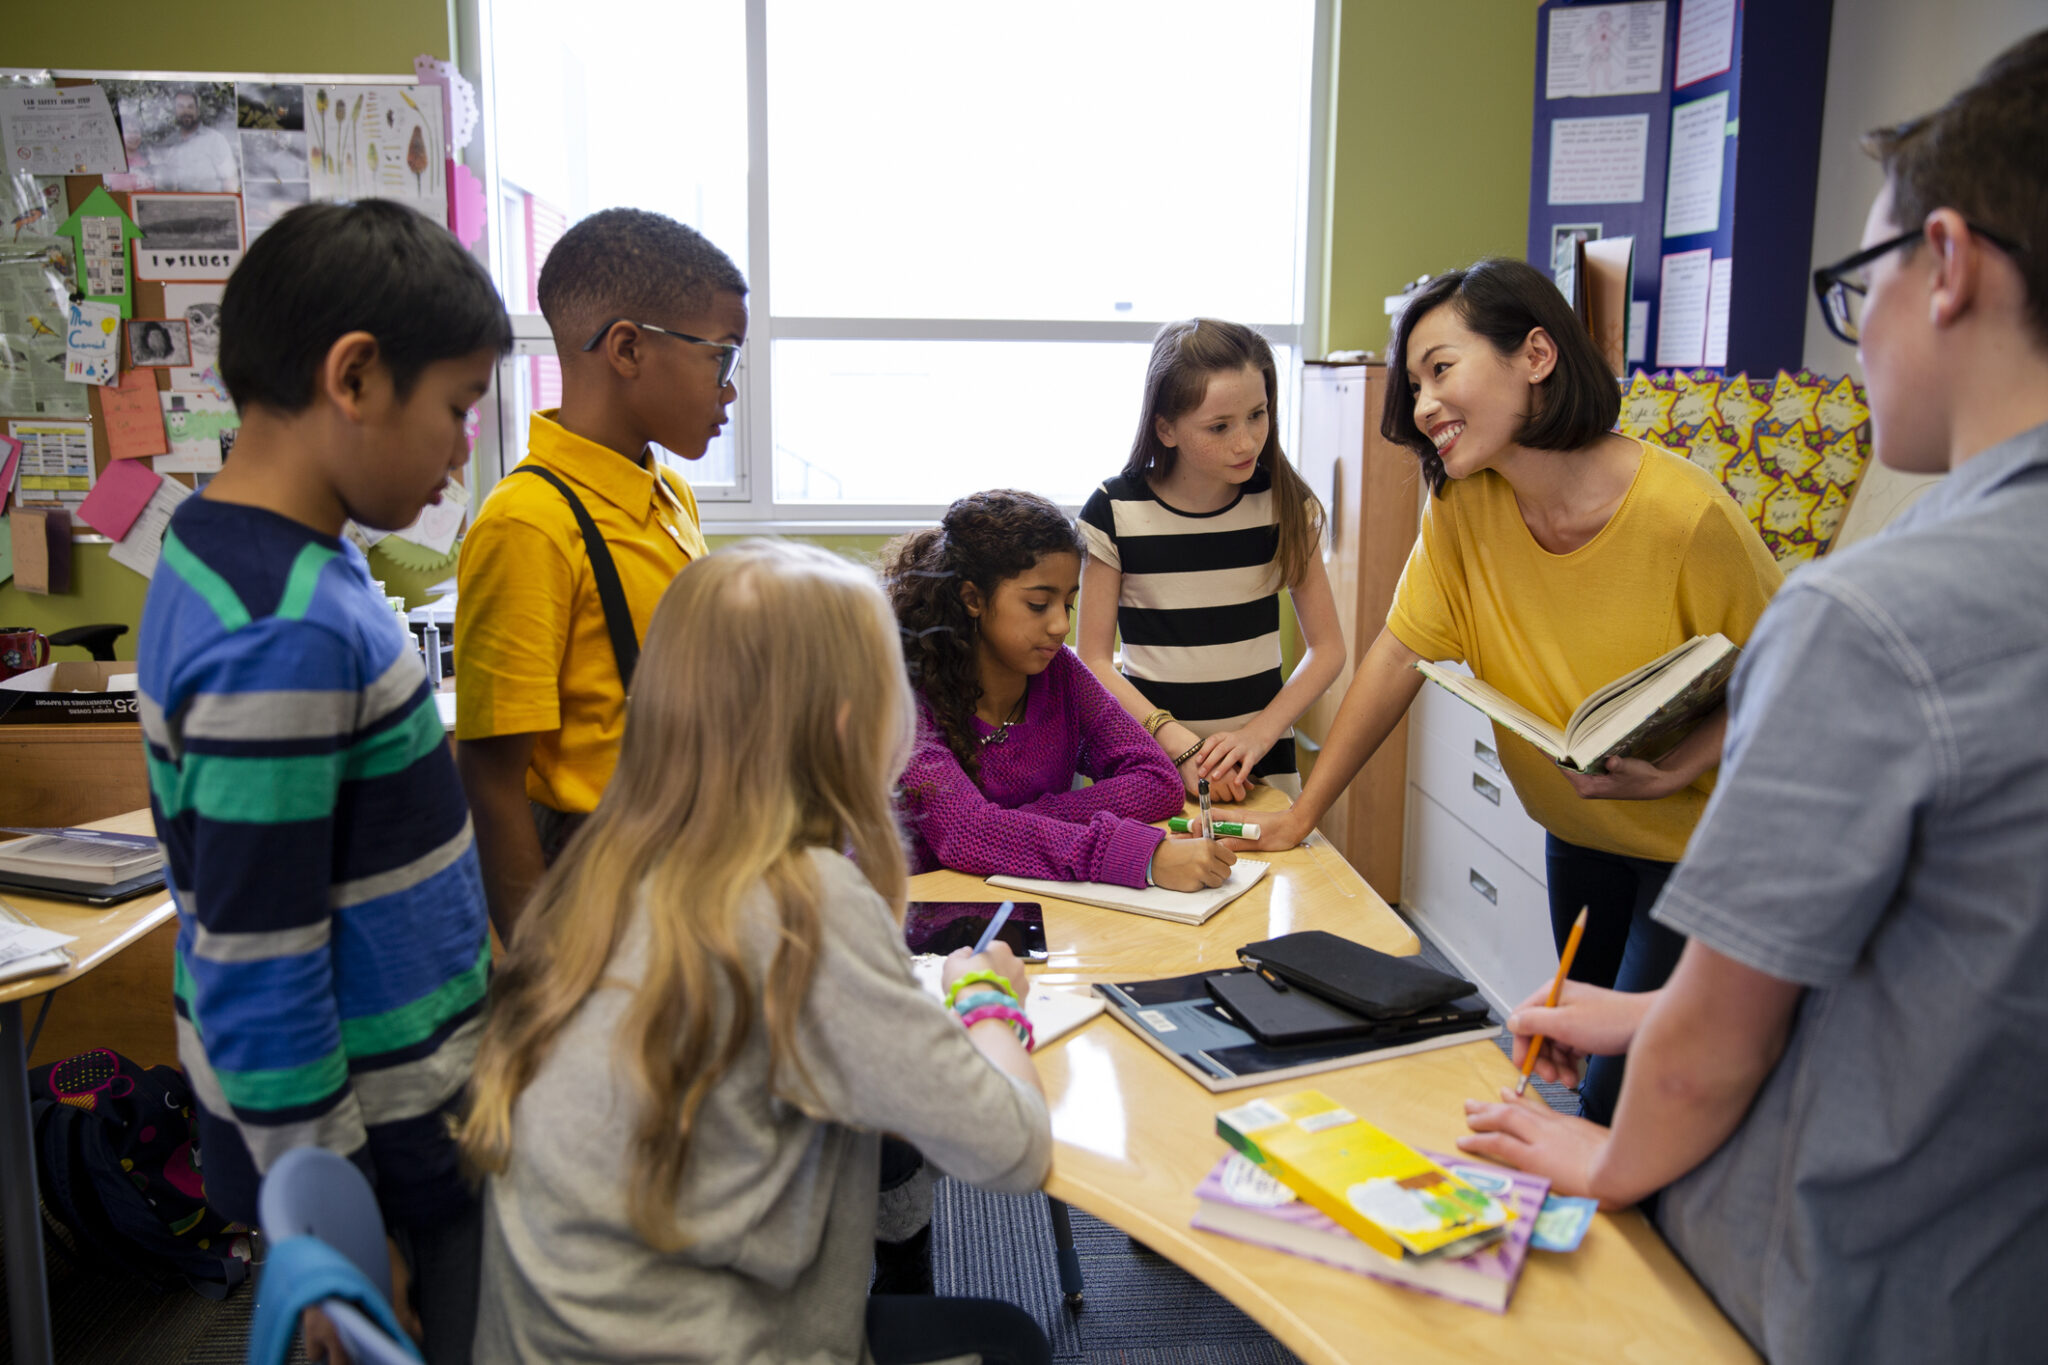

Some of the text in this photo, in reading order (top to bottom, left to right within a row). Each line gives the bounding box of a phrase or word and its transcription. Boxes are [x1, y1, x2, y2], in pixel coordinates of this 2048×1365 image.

[152, 255, 230, 267] I SLUGS
[113, 699, 140, 713] 25
